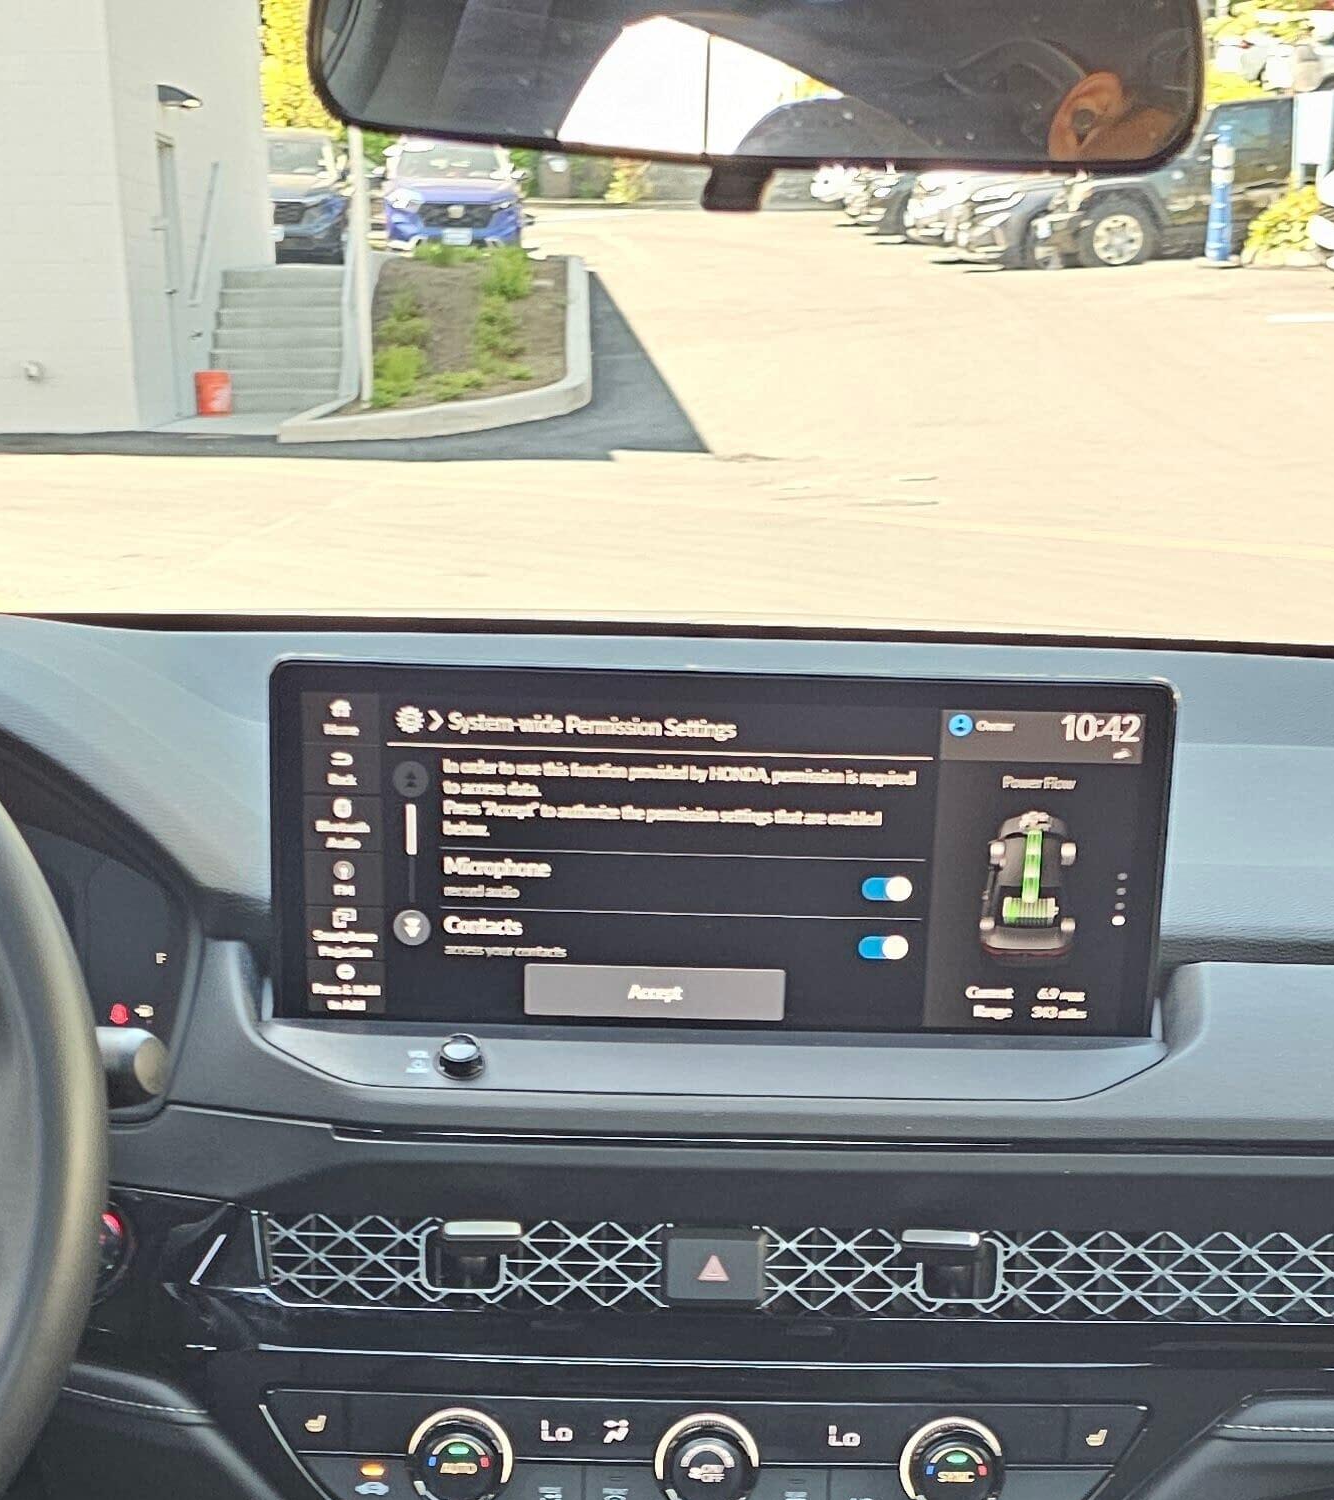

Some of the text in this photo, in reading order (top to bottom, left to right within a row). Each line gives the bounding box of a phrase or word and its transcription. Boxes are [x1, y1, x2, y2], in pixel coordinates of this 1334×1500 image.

[447, 711, 738, 742] System-wide Permission Settings
[1061, 712, 1141, 743] 10:42
[443, 856, 552, 880] Microphone
[443, 915, 524, 936] Contacts
